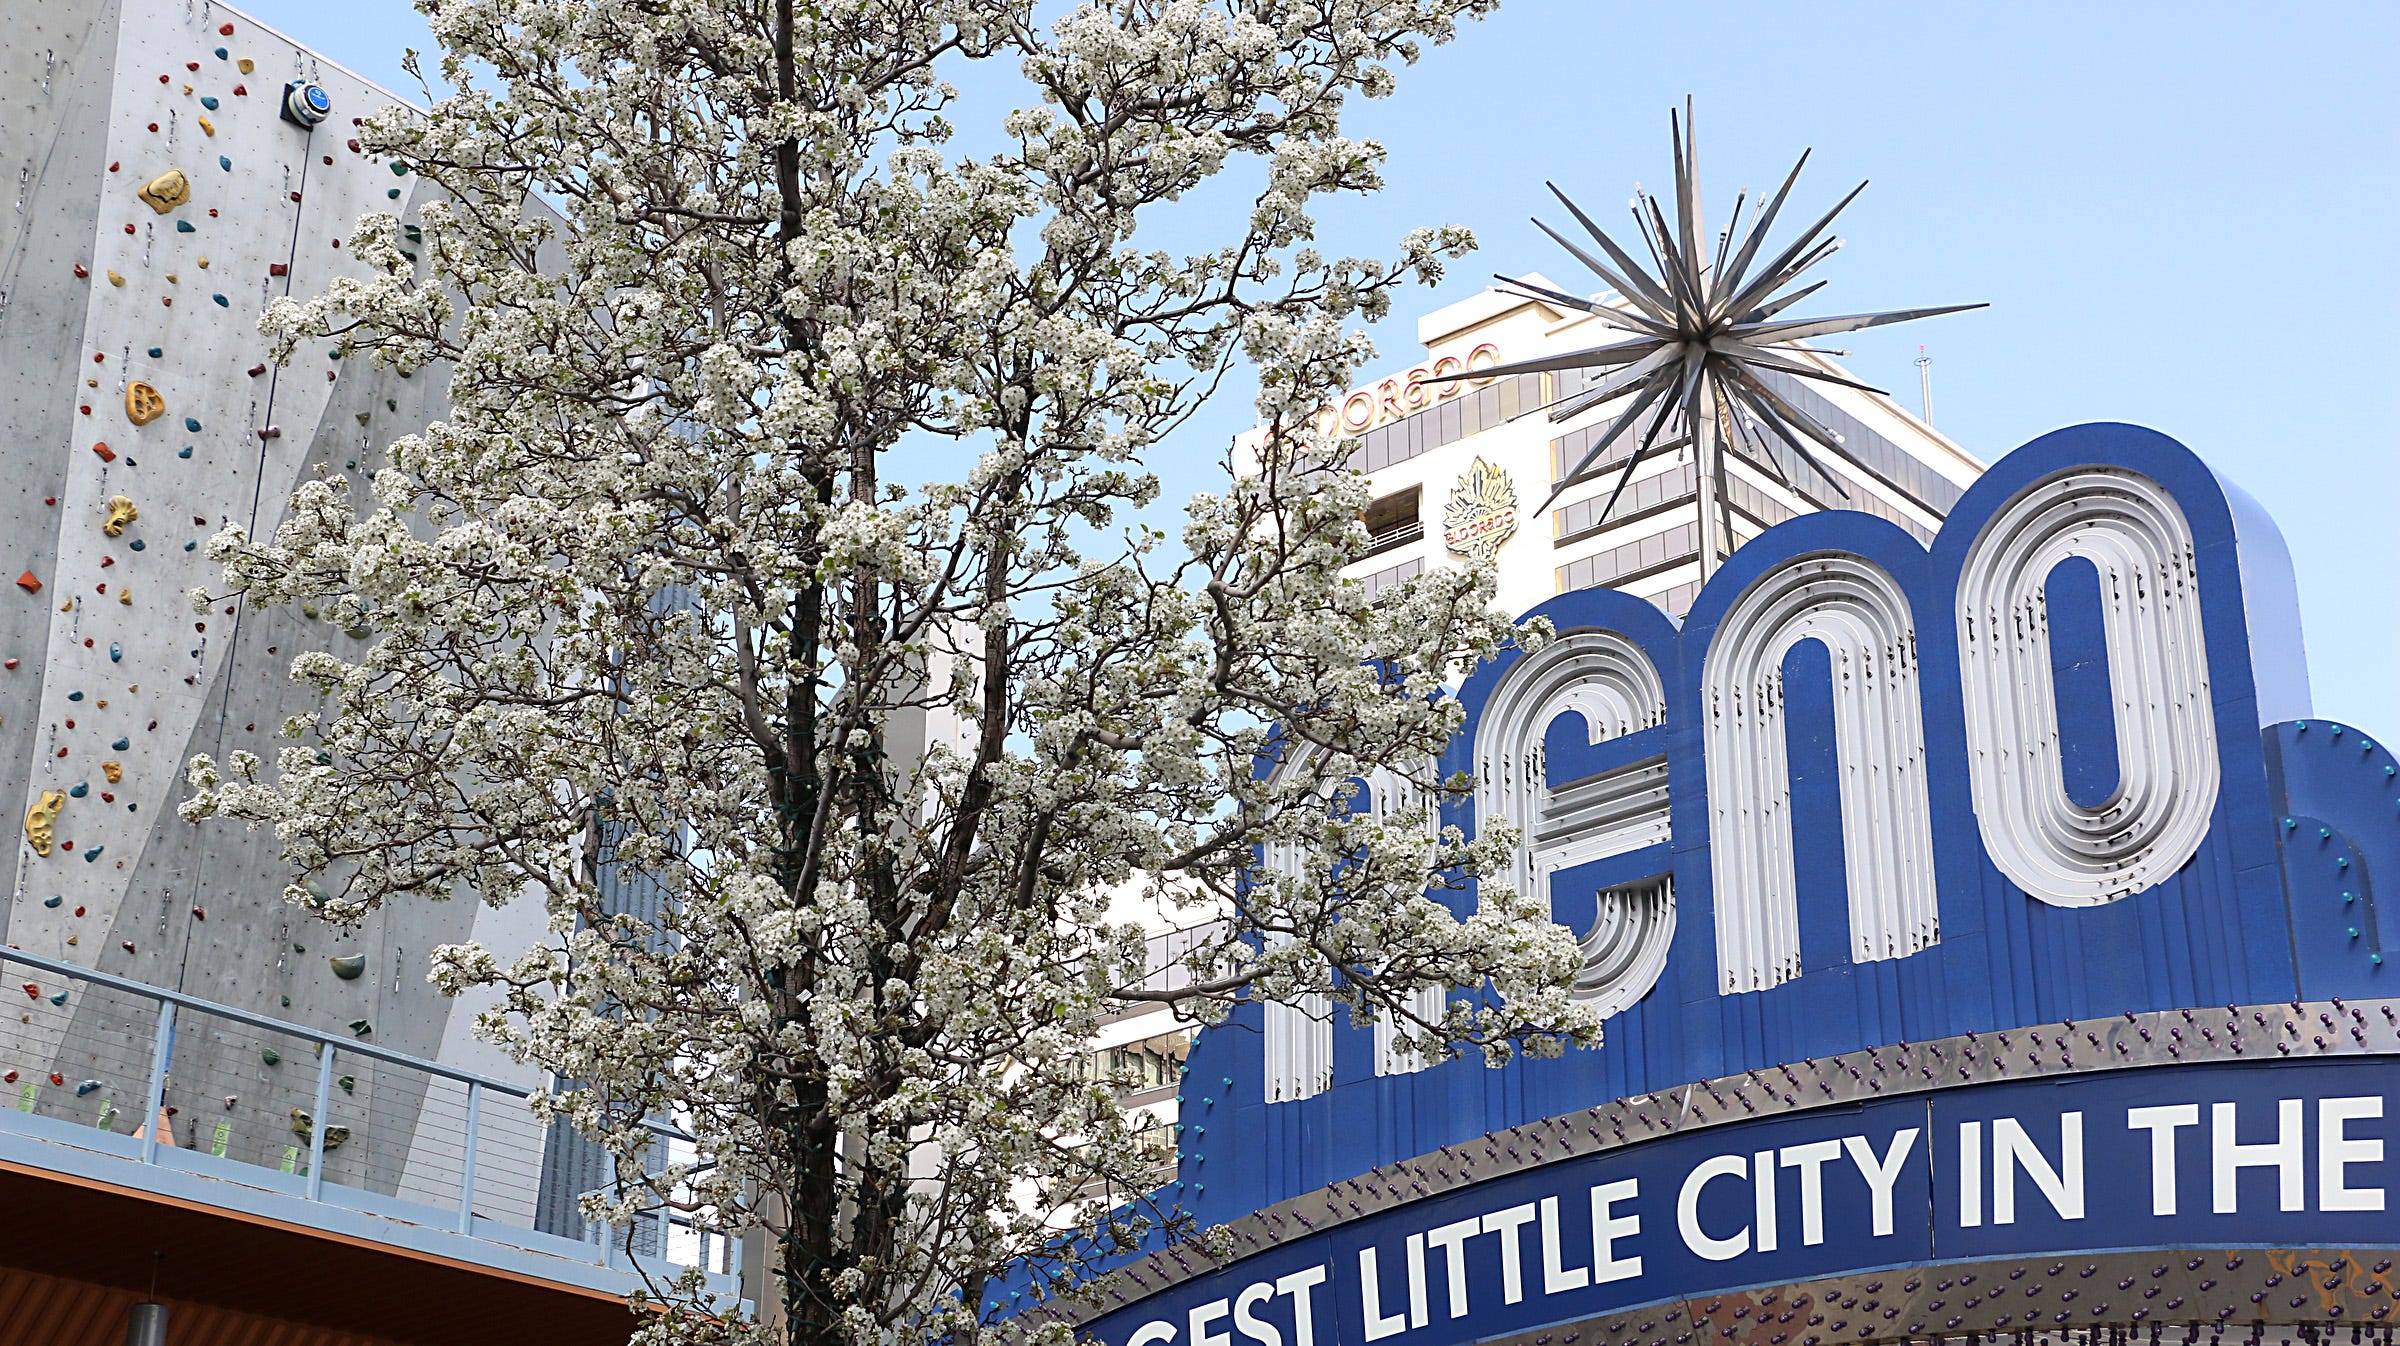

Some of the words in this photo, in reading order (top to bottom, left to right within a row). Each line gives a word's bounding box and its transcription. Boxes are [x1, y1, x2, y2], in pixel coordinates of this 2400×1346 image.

[1125, 1264, 1326, 1346] ST
[1359, 1178, 1643, 1342] LITTLE
[1677, 1128, 1920, 1261] CITY
[1959, 1111, 2085, 1228] IN
[2127, 1096, 2385, 1216] THE
